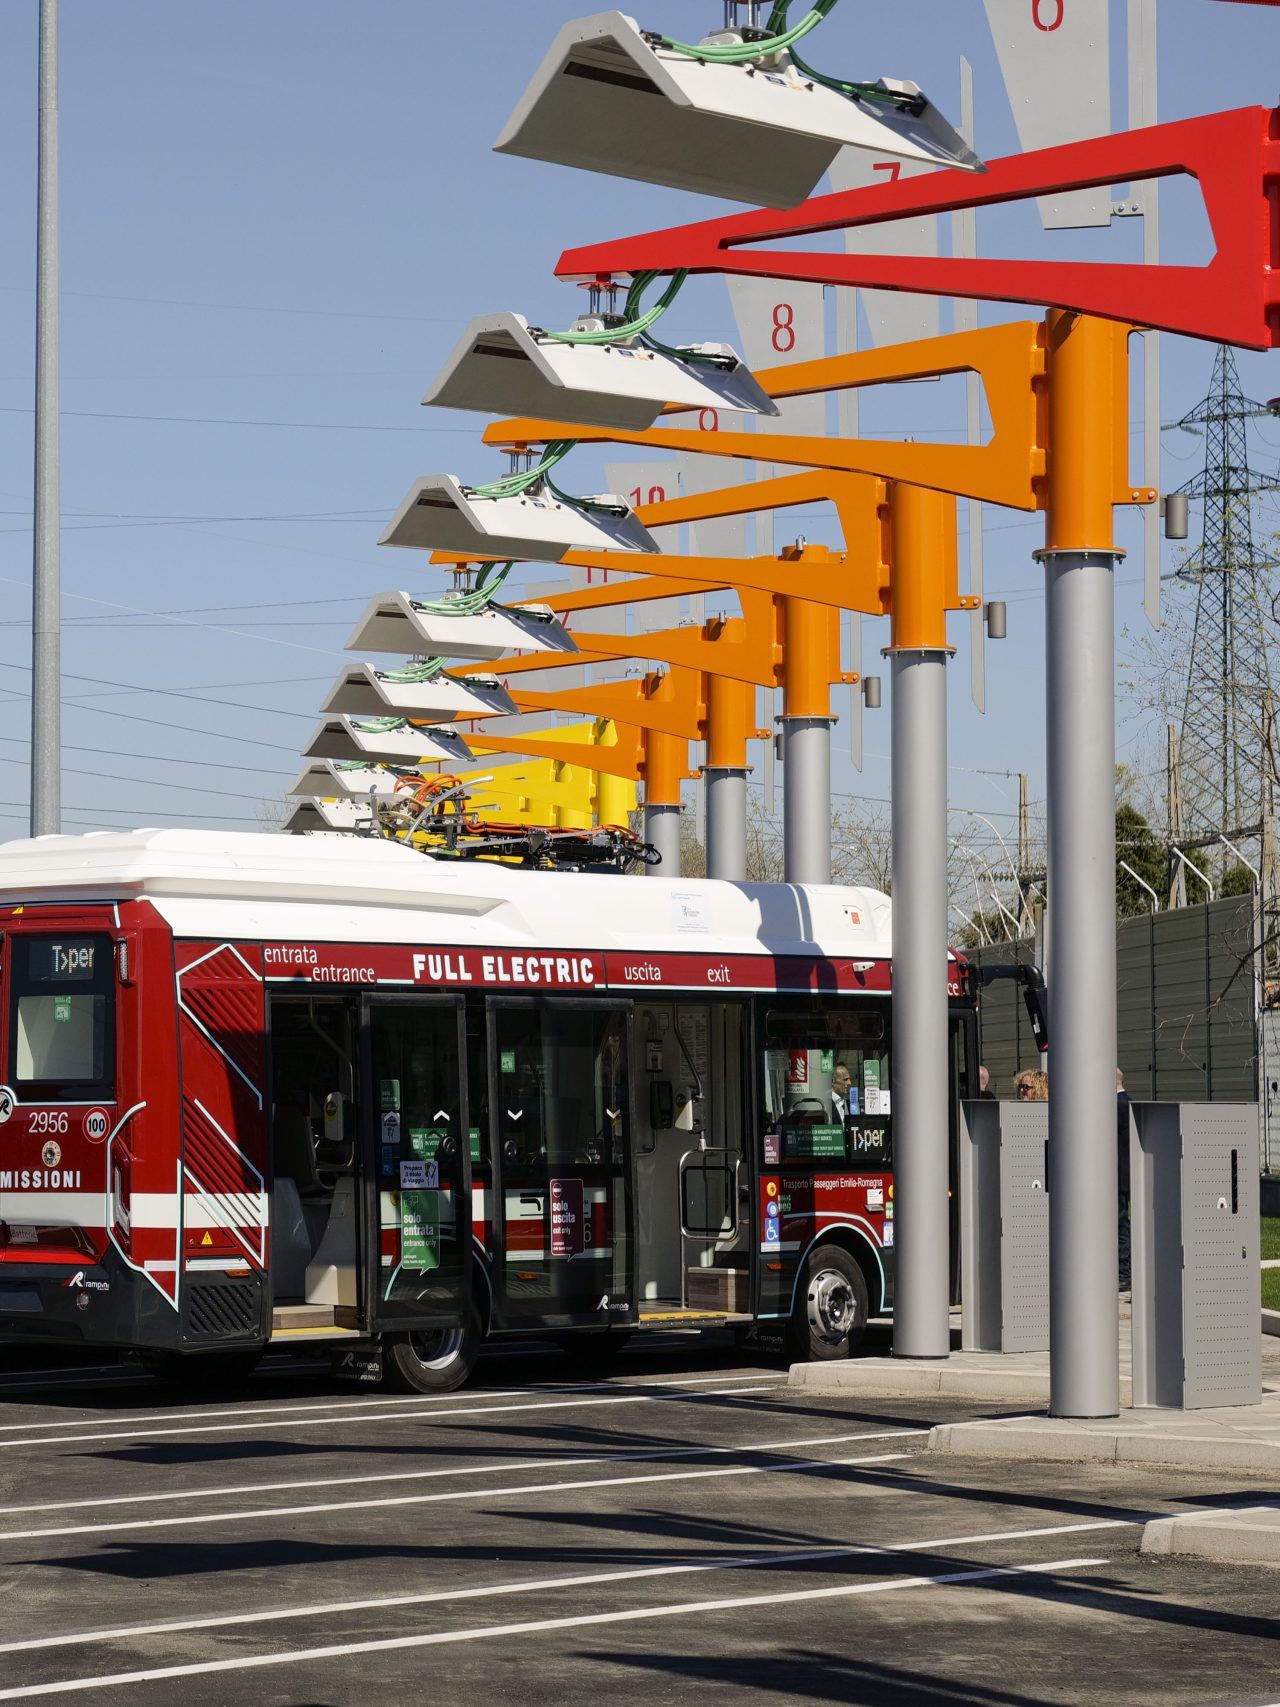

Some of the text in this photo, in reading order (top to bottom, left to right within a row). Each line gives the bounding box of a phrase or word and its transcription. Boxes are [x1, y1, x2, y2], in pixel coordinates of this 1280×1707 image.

[772, 304, 795, 353] 8
[264, 945, 318, 964] entrata
[312, 964, 375, 983] entrance
[412, 953, 594, 984] FULL ELECTRIC
[624, 961, 662, 981] uscita
[707, 963, 731, 983] exit
[28, 1111, 69, 1134] 2956
[88, 1118, 105, 1133] 100
[783, 1177, 883, 1191] Trasporto Passeggeri Emilia-Romagna
[553, 1200, 569, 1212] solo
[403, 1213, 422, 1224] solo
[553, 1212, 576, 1224] uscita
[403, 1224, 434, 1236] entrata
[85, 1280, 110, 1290] rampini
